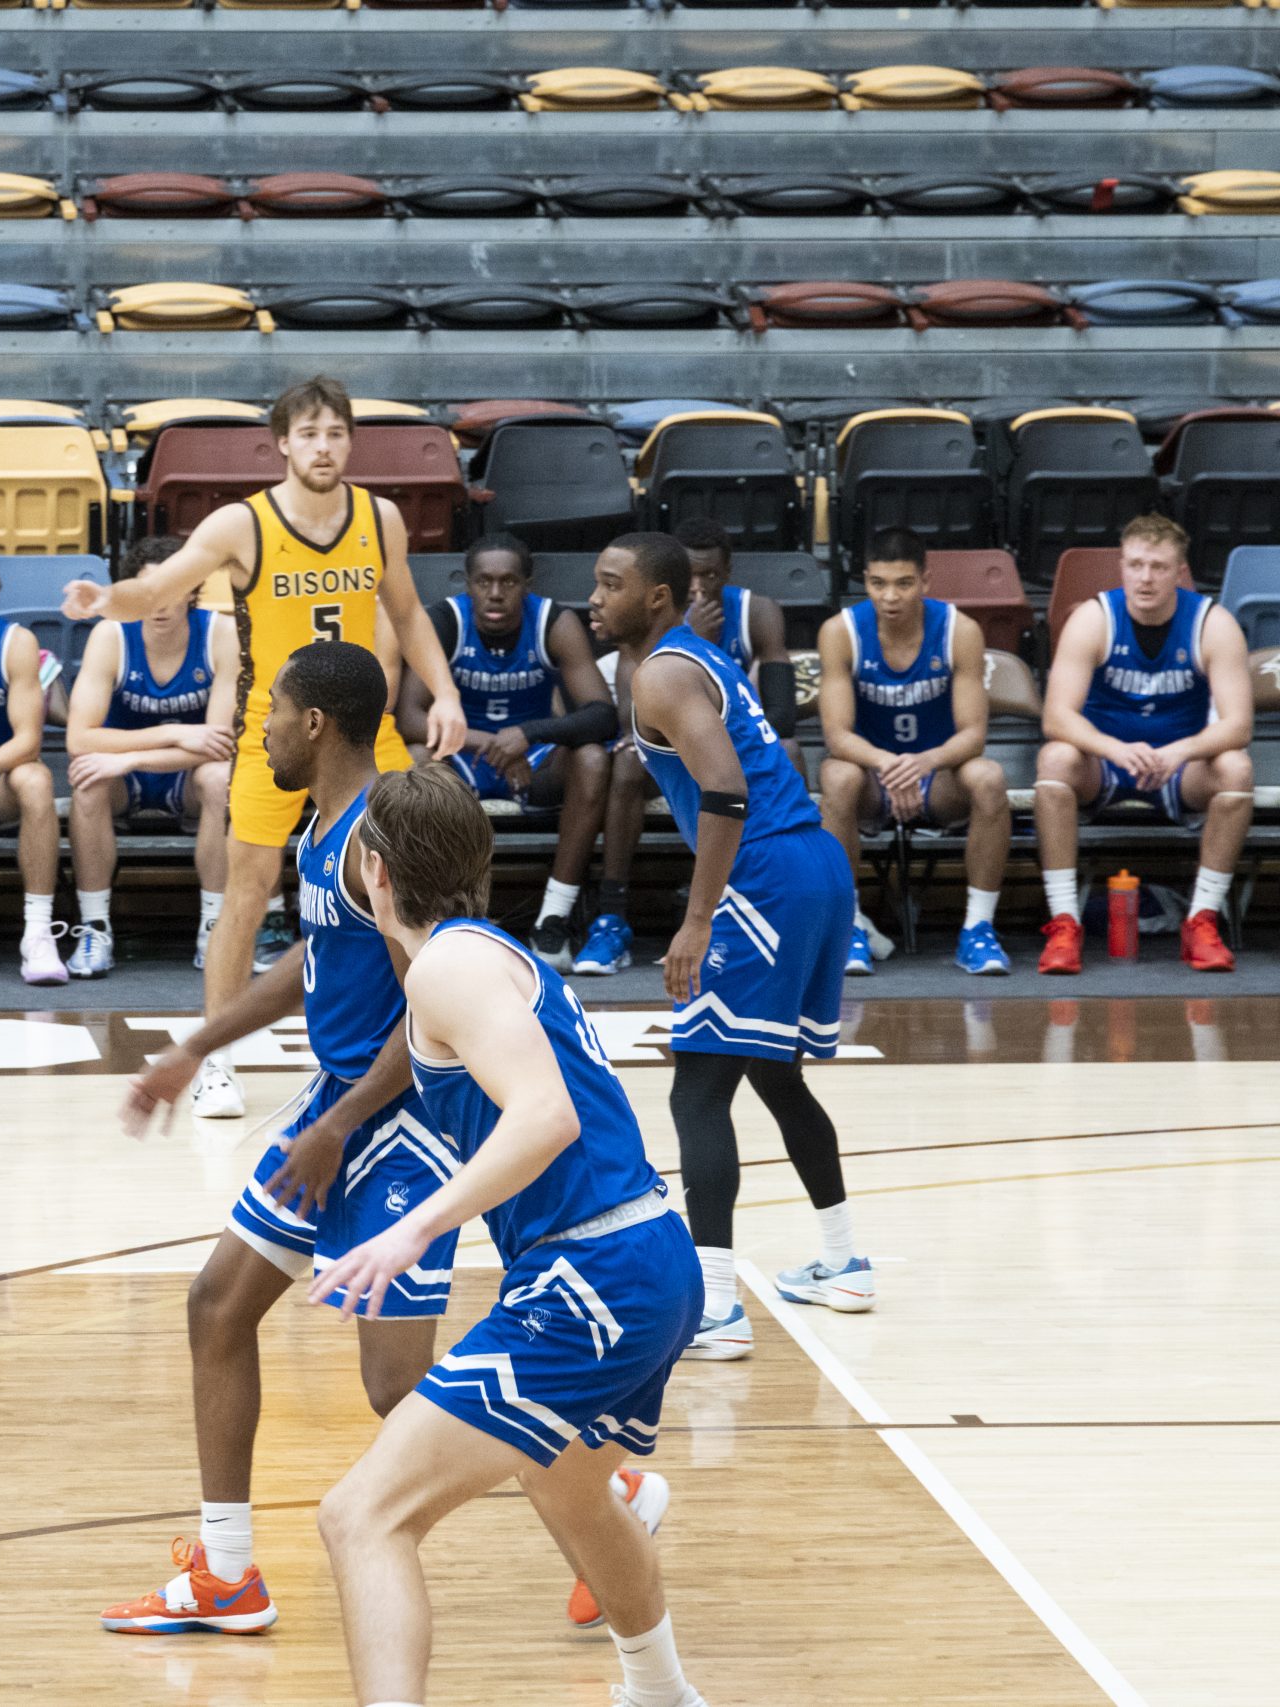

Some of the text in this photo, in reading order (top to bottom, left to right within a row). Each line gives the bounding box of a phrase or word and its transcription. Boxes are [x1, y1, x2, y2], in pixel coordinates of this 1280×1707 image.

[272, 564, 376, 599] BISONS
[311, 603, 343, 643] 5
[486, 698, 510, 721] 5
[894, 713, 918, 743] 9
